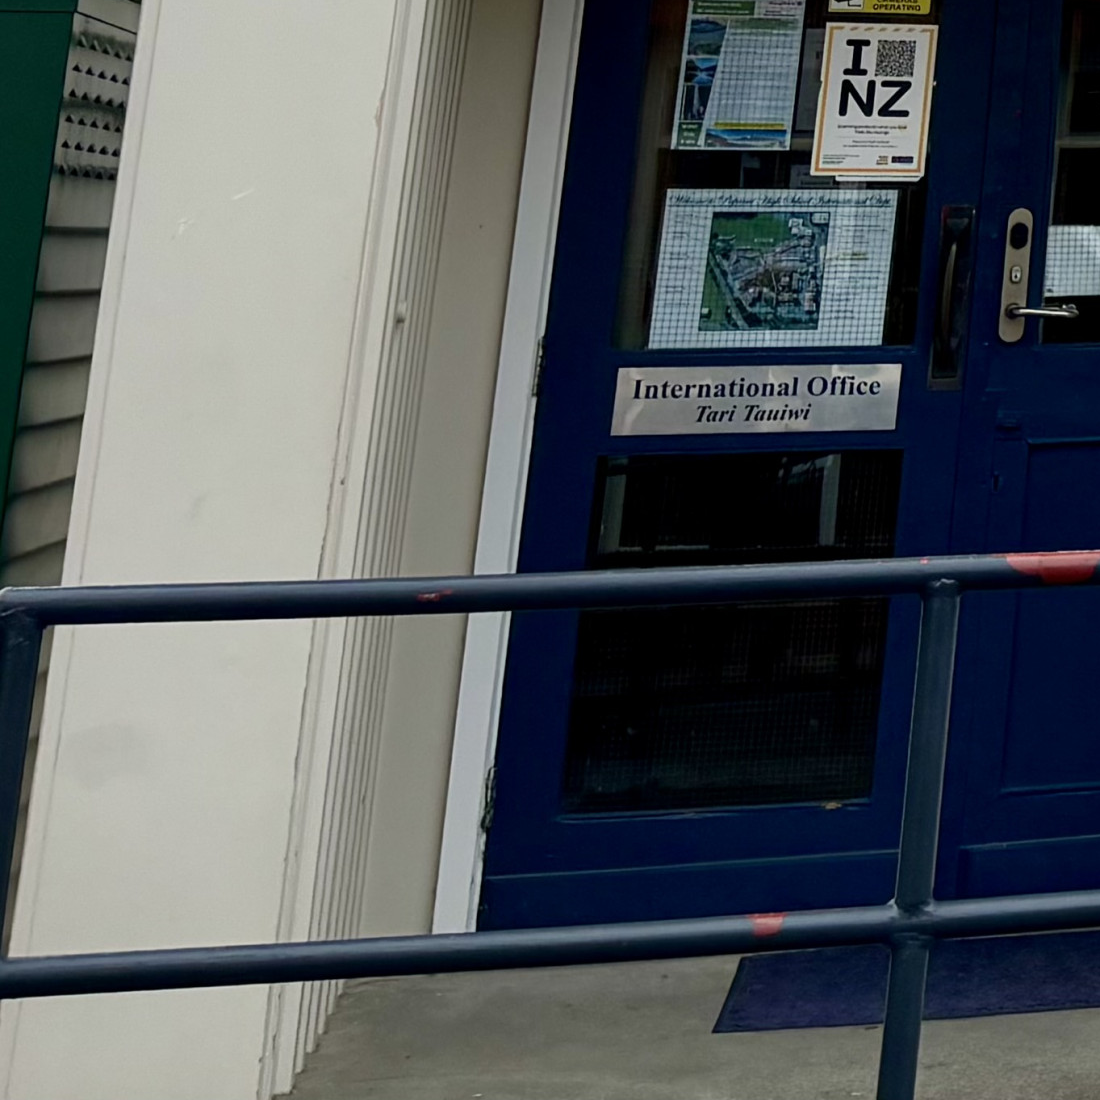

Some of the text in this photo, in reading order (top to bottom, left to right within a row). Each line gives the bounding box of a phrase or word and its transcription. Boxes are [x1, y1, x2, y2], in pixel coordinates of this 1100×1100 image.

[872, 3, 921, 12] OPERATING
[838, 79, 913, 117] NZ
[632, 375, 881, 399] International Office
[695, 403, 812, 423] Tari Tauiwi
